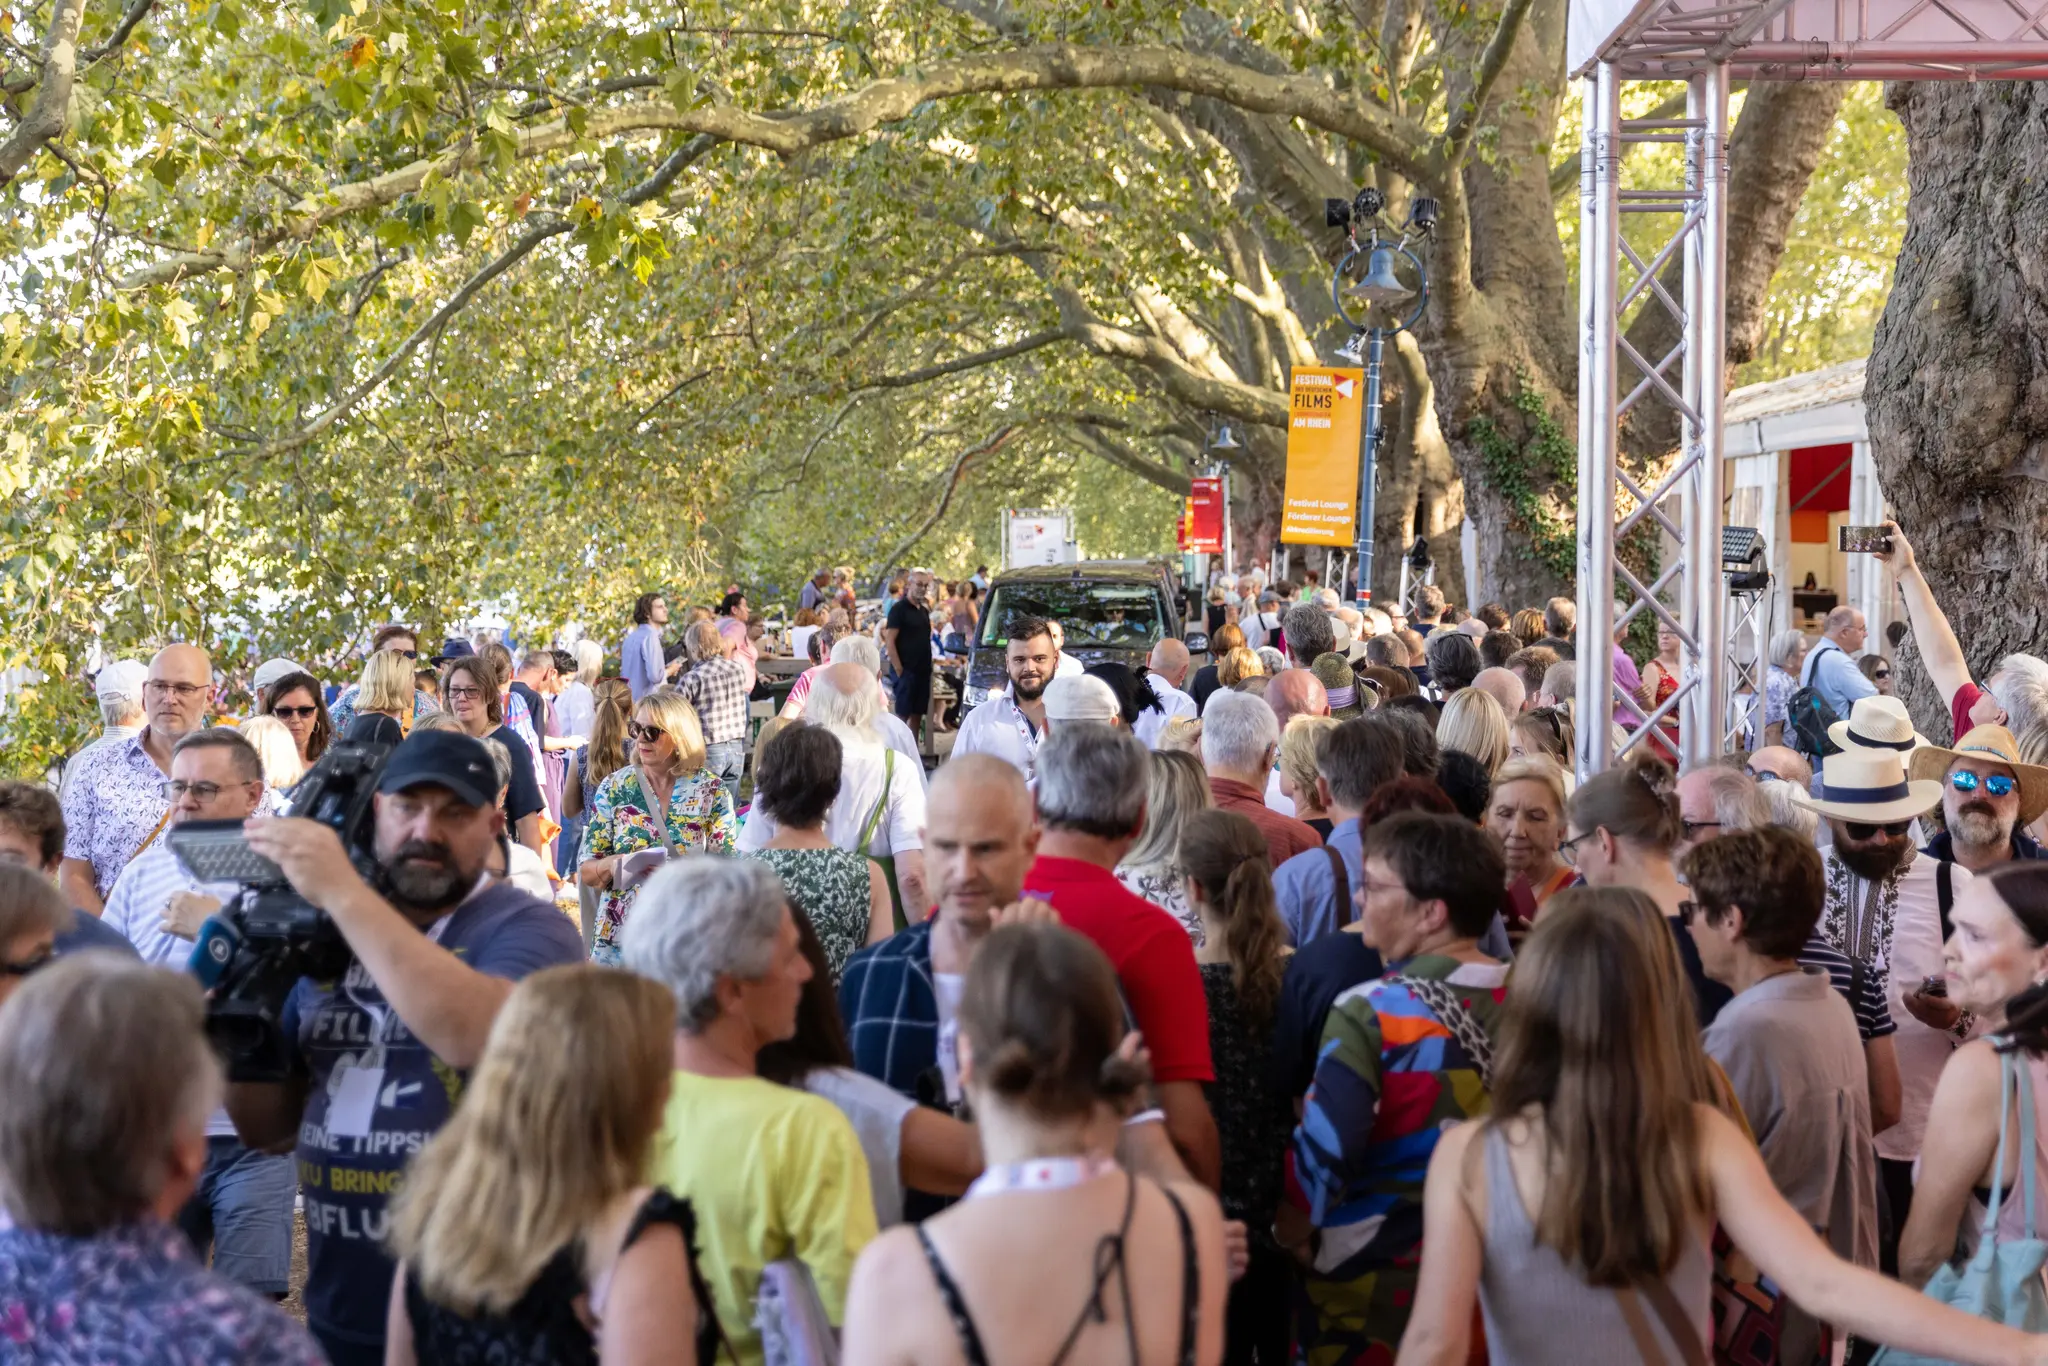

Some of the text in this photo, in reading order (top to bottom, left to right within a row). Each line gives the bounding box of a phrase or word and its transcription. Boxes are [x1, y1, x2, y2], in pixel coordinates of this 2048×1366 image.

[1295, 374, 1332, 386] FESTIVAL
[1294, 394, 1332, 408] FILMS
[1293, 418, 1331, 428] AM RHEIN
[1288, 498, 1349, 510] Festival Lounge
[1287, 511, 1352, 525] Förderer Lounge
[300, 1121, 340, 1152] EINE
